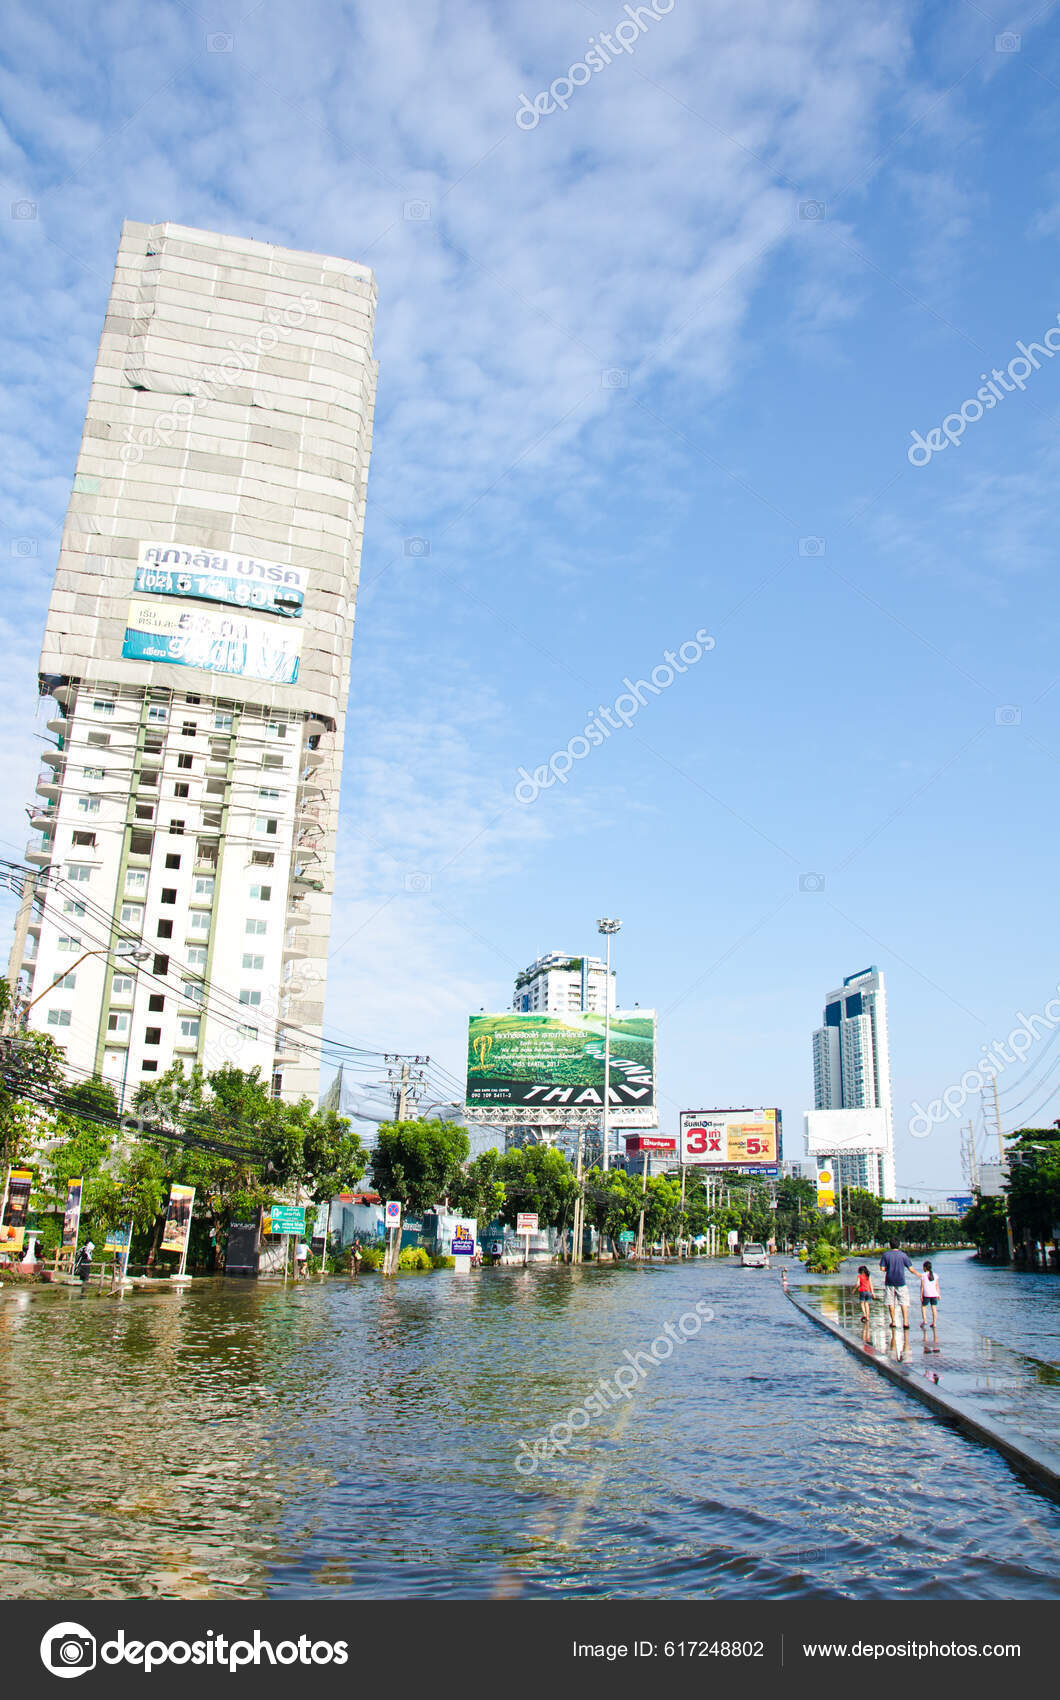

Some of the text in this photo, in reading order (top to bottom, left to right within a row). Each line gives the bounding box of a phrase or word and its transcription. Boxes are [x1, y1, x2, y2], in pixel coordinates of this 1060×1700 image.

[522, 1060, 653, 1104] THAILAND
[686, 1127, 708, 1153] 3
[746, 1138, 761, 1154] 5
